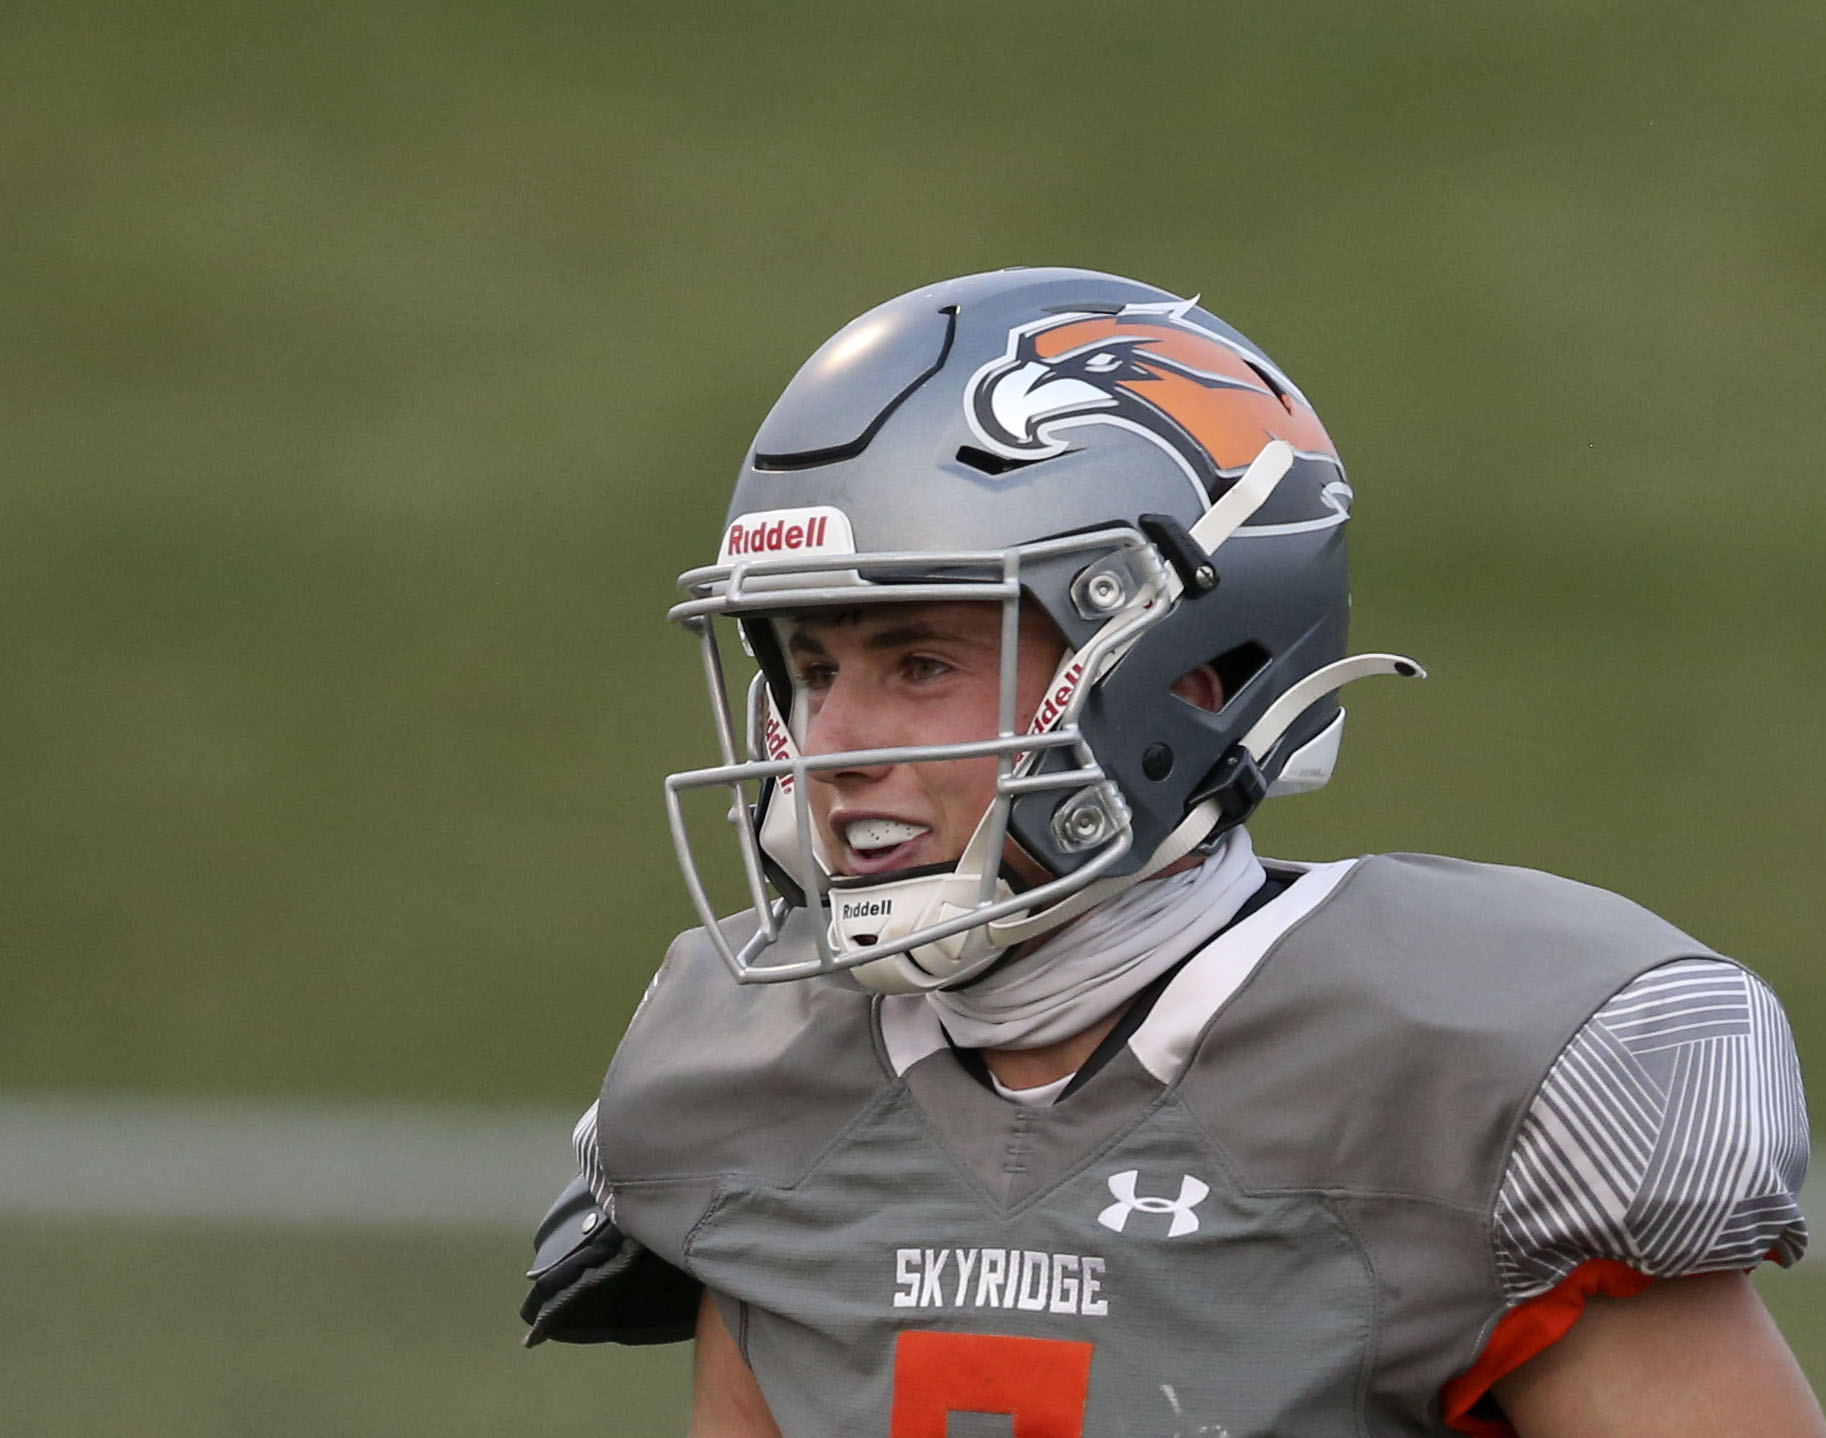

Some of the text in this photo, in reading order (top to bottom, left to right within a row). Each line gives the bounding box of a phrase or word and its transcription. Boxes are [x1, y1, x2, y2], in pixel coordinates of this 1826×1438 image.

[728, 515, 828, 555] Riddell
[843, 899, 892, 919] Riddell
[893, 1248, 1109, 1316] SKYRIDGE
